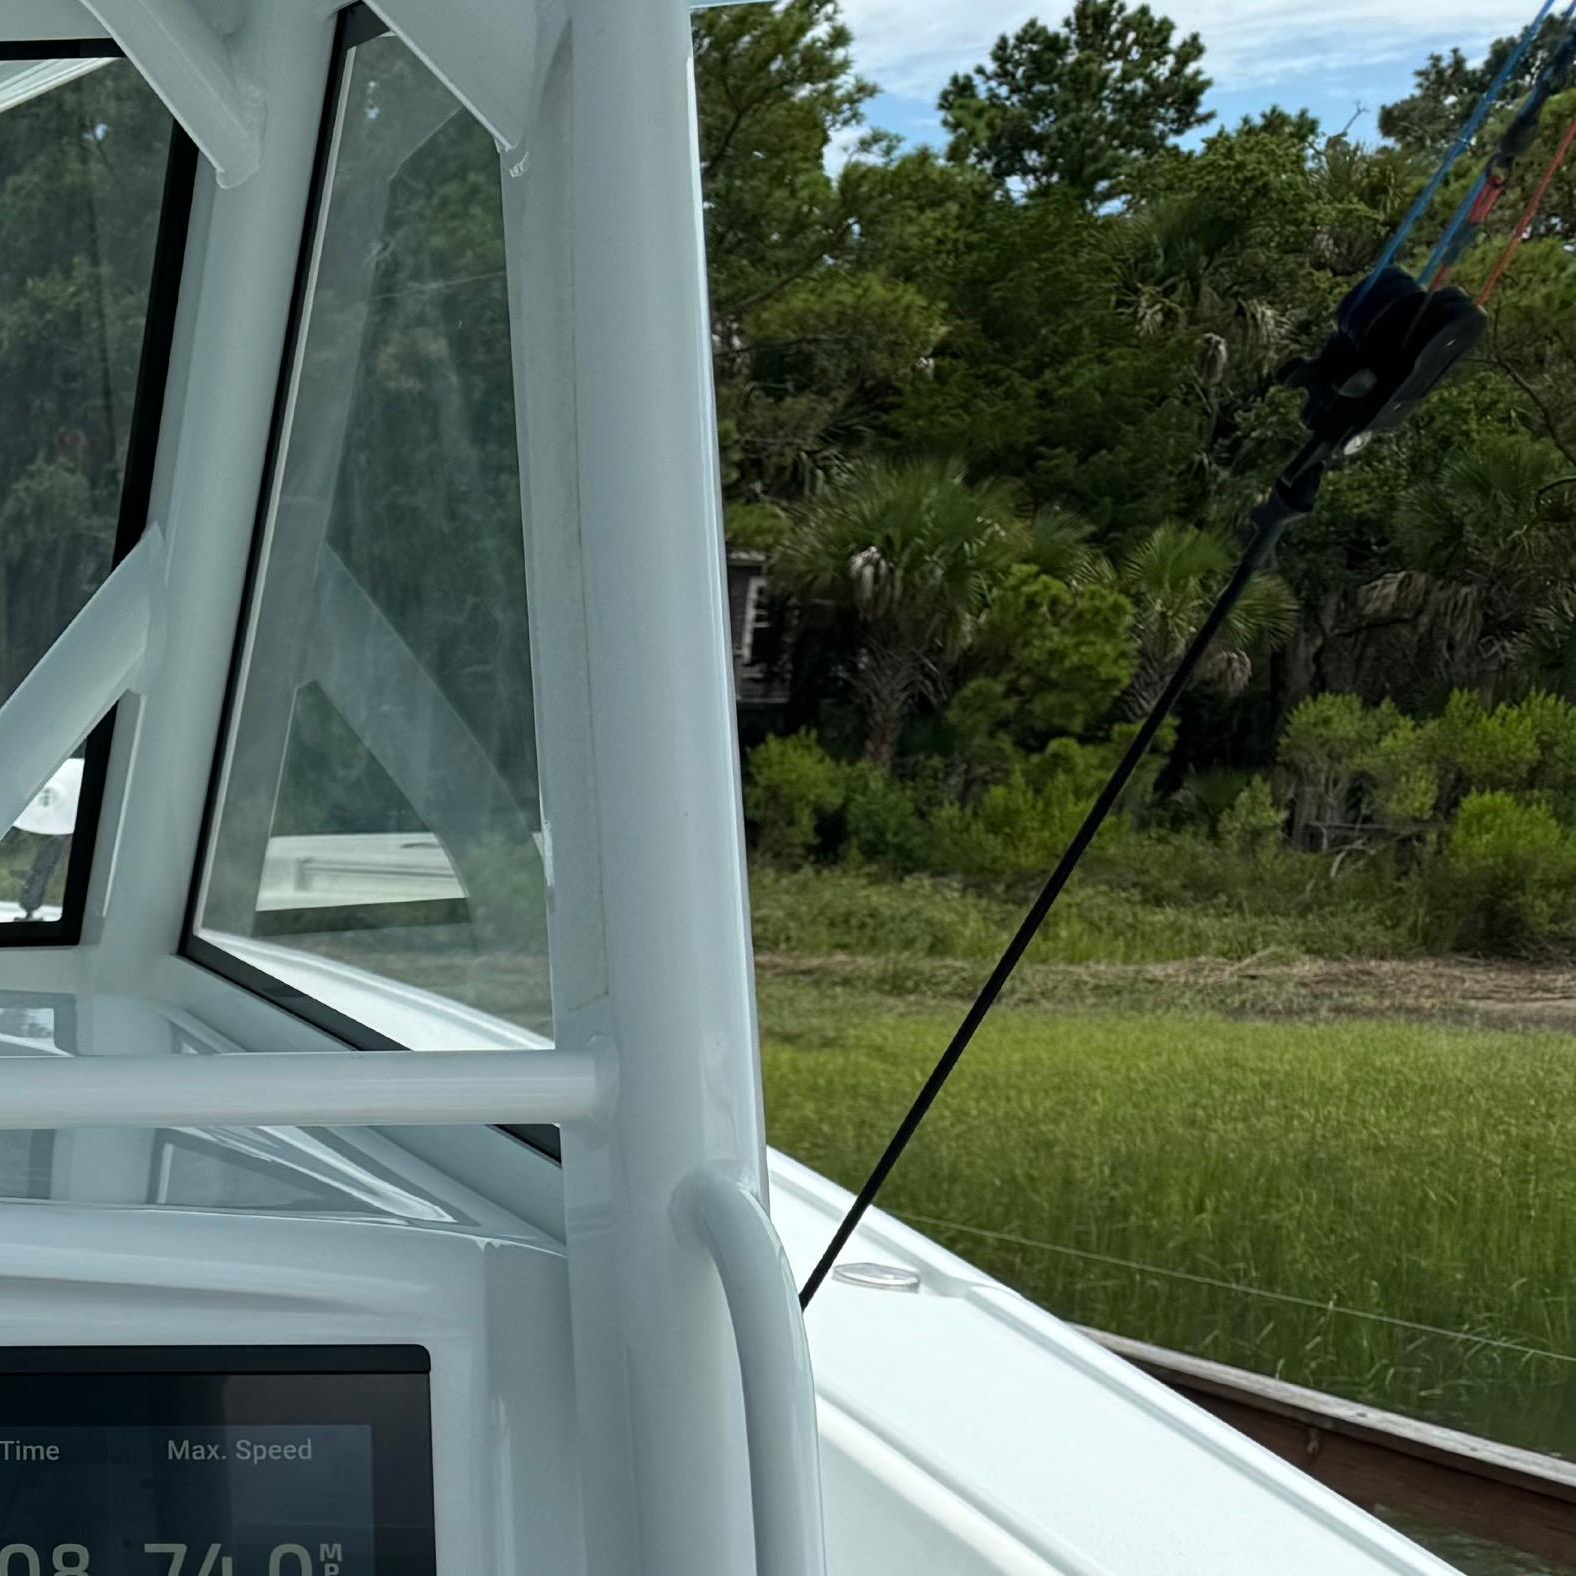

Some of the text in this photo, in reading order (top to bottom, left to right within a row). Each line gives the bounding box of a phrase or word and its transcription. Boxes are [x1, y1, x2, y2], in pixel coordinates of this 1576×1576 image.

[0, 1441, 60, 1461] Time
[168, 1439, 313, 1464] Max. Speed
